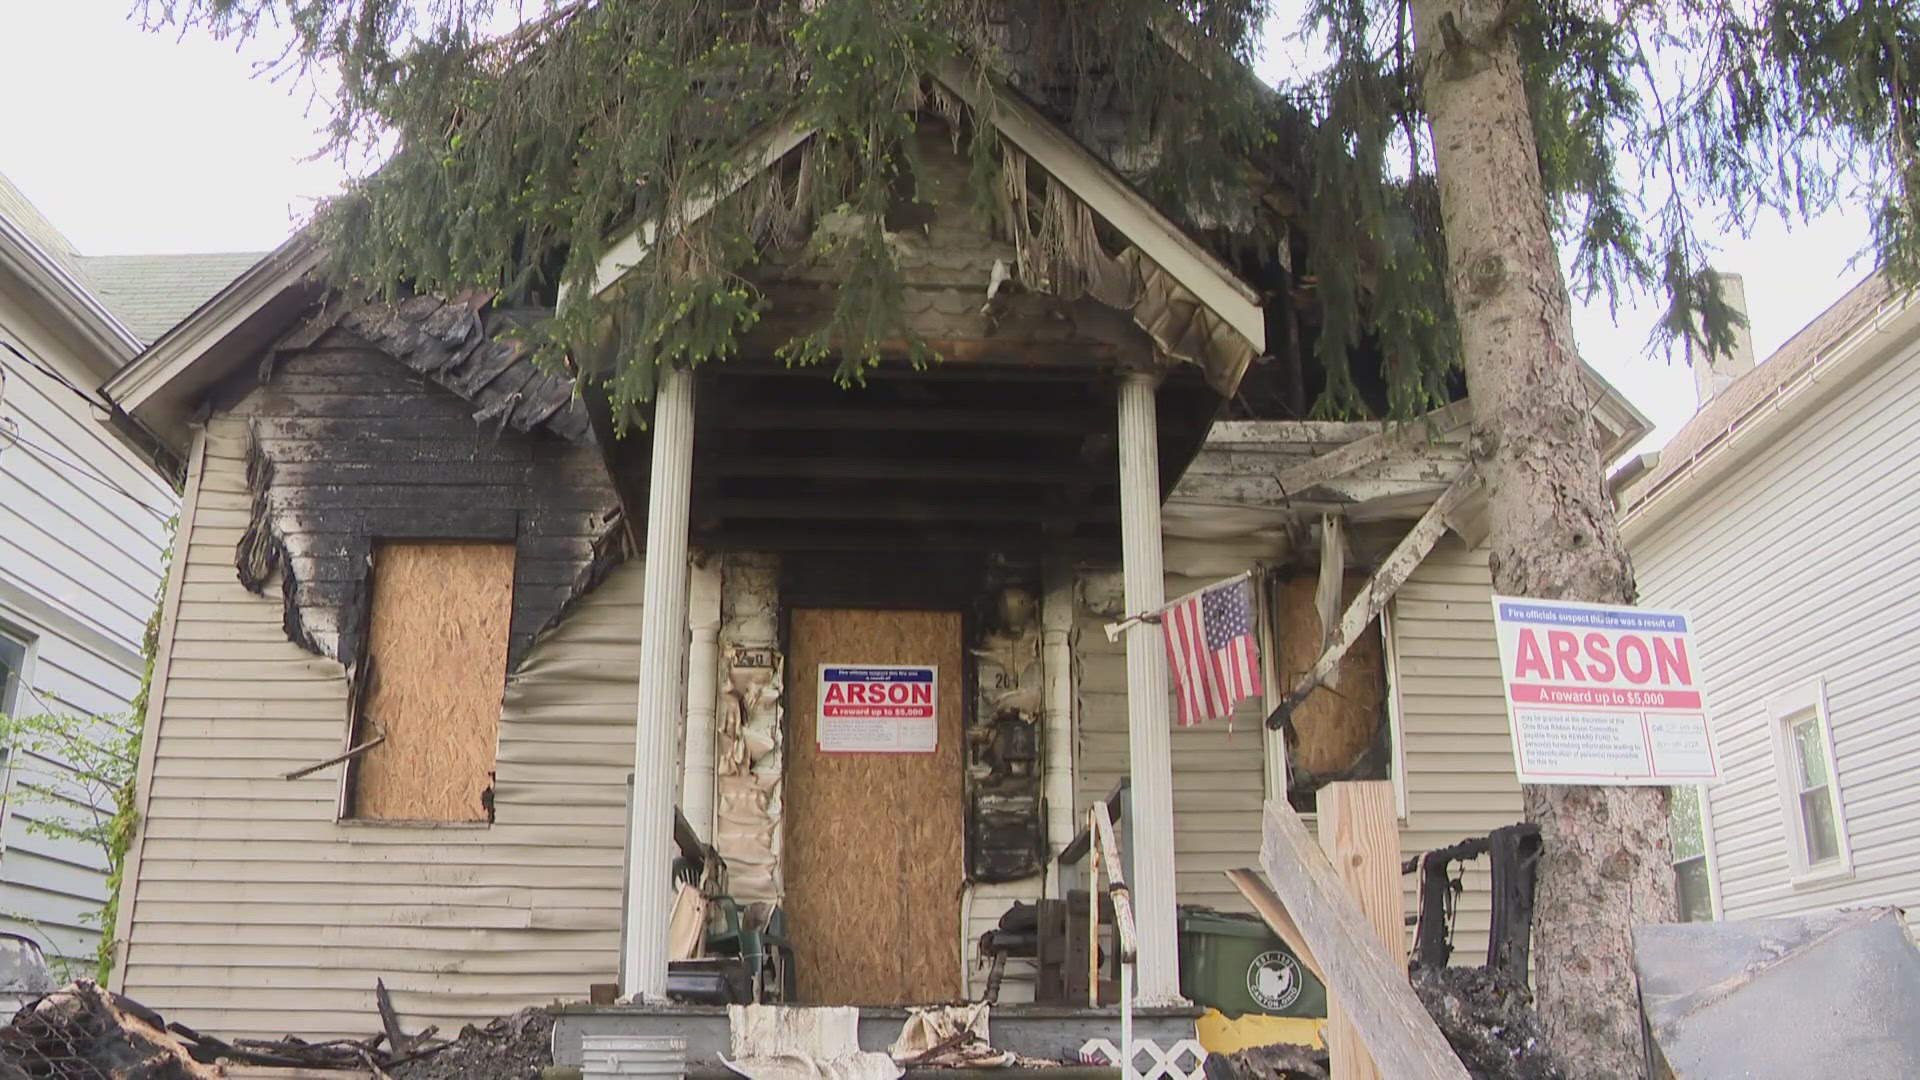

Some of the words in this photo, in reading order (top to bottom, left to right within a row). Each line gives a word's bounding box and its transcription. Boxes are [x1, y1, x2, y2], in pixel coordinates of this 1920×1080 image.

[1508, 608, 1524, 619] Fire
[1526, 609, 1557, 621] officials
[1558, 612, 1589, 624] suspect
[1620, 617, 1636, 627] was
[1638, 619, 1643, 627] a
[1644, 617, 1666, 628] result
[1667, 618, 1676, 628] of
[1515, 628, 1692, 686] ARSON
[825, 683, 931, 704] ARSON
[1540, 688, 1549, 701] A
[1551, 688, 1593, 703] reward
[1595, 693, 1610, 707] up
[1612, 691, 1625, 704] to
[1627, 692, 1664, 707] $5,000
[832, 707, 838, 715] A
[840, 707, 869, 715] reward
[871, 708, 881, 717] up
[884, 707, 893, 715] to
[895, 707, 924, 716] $5,000
